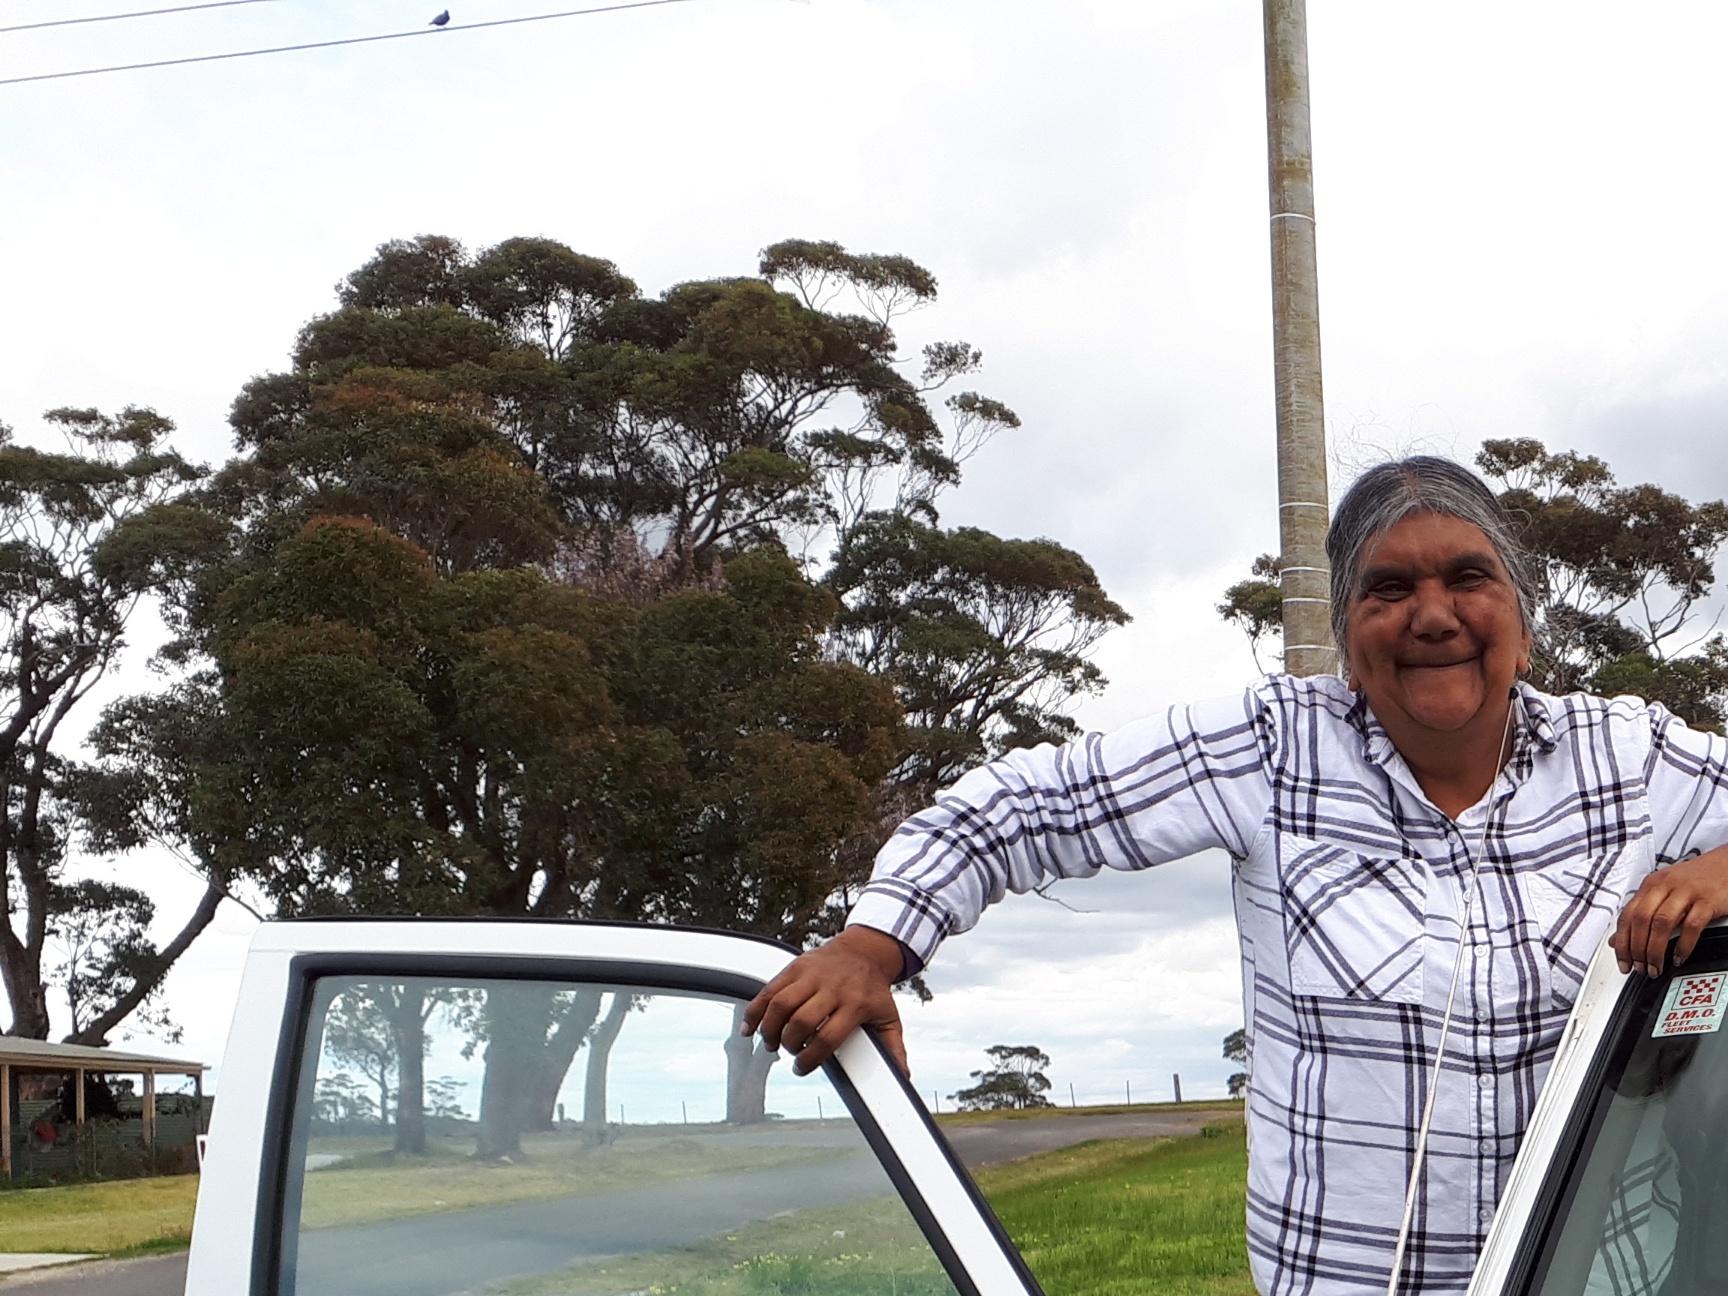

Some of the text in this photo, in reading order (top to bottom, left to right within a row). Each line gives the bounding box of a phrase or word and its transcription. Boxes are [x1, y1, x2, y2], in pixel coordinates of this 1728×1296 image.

[1679, 995, 1712, 1006] CFA
[1665, 1009, 1716, 1021] D.M.O.
[1661, 1020, 1692, 1028] FLEET
[1663, 1024, 1713, 1034] SERVICES
